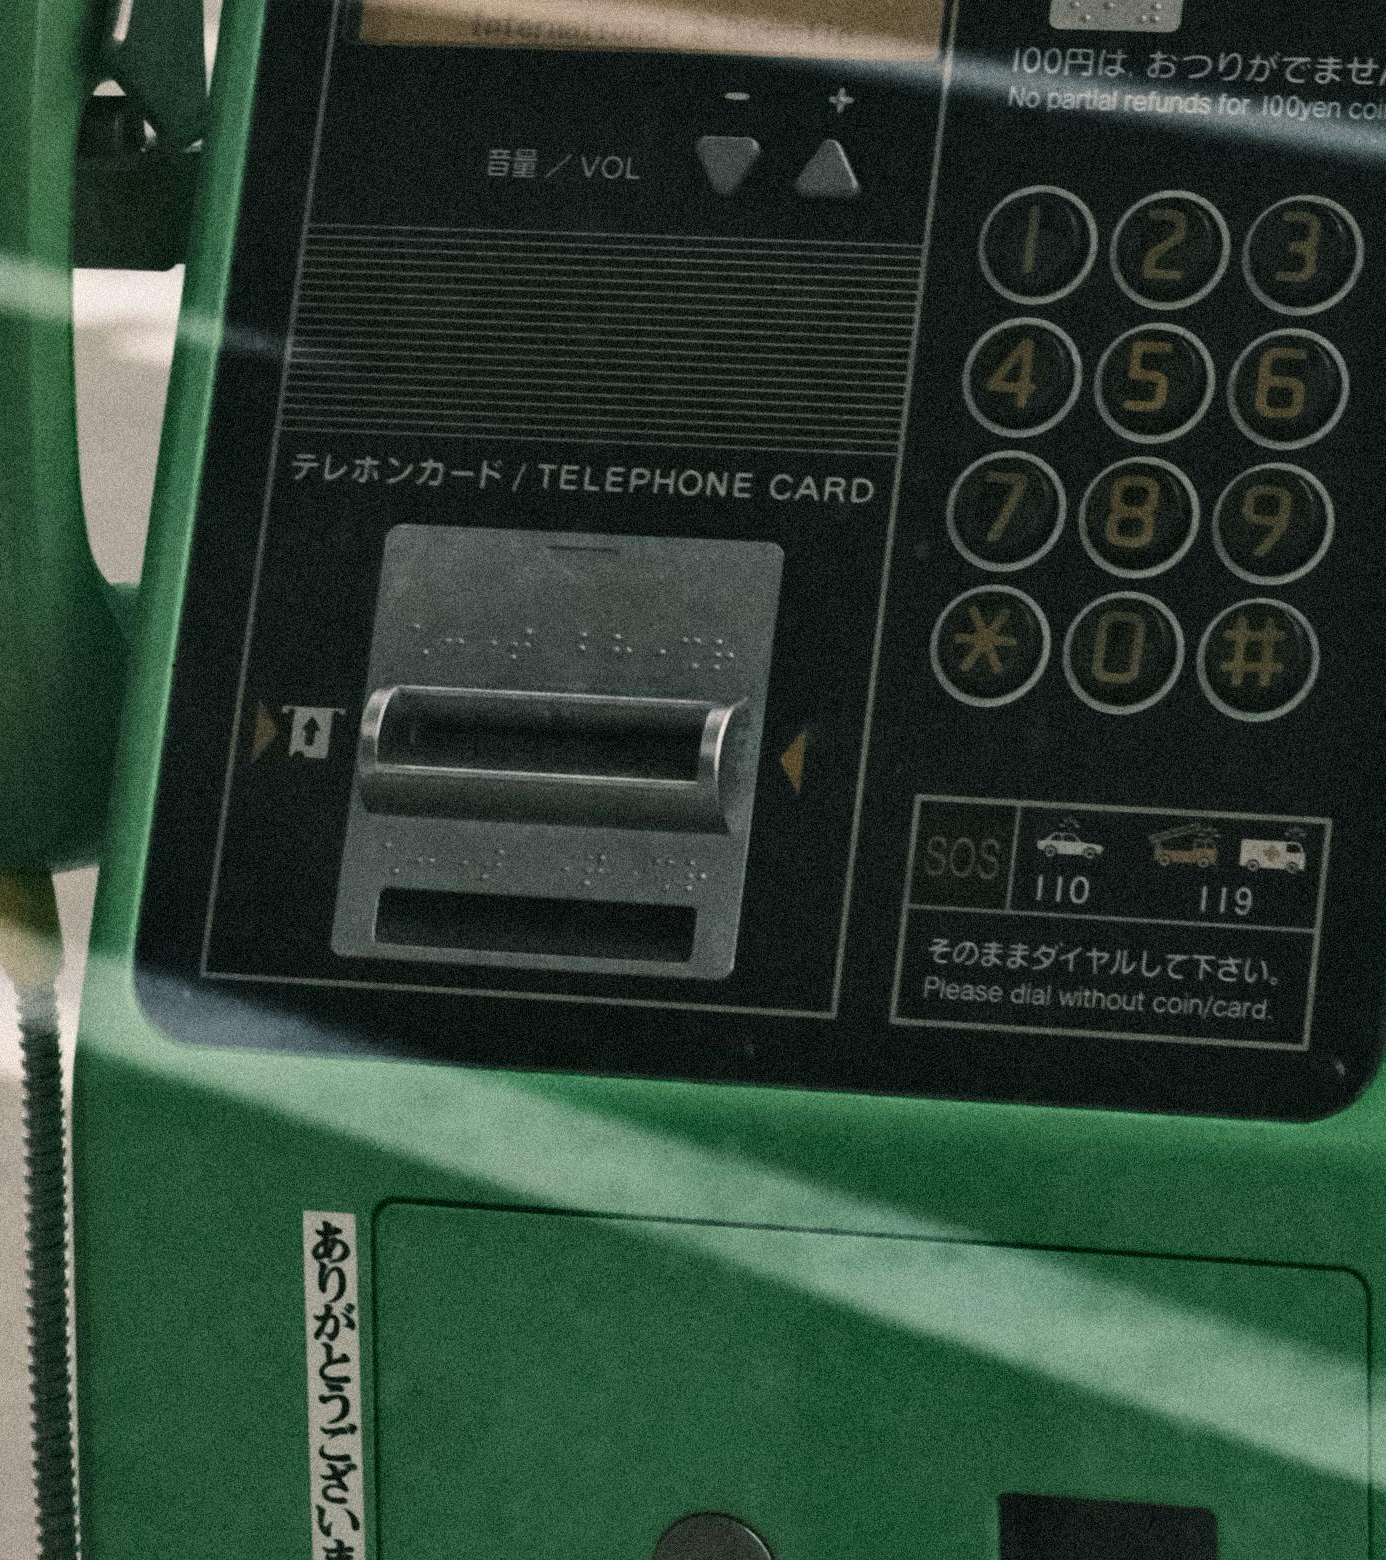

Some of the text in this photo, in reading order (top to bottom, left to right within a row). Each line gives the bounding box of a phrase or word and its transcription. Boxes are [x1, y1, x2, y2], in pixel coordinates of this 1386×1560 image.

[1008, 87, 1042, 112] No
[1046, 89, 1117, 118] partial
[1122, 90, 1211, 118] refunds
[1216, 93, 1250, 117] for
[486, 147, 540, 180] 音量
[581, 155, 641, 181] VOL
[1140, 207, 1189, 281] 2
[1274, 210, 1324, 283] 3
[986, 338, 1310, 421] 4 5 6
[290, 451, 502, 486] テレホンカード
[537, 463, 754, 500] TELEPHONE
[768, 472, 876, 505] CARD
[984, 470, 1295, 558] 7 8 9
[923, 834, 1001, 882] SOS
[1034, 874, 1091, 906] 110
[1199, 884, 1254, 917] 119
[927, 937, 1280, 987] そのままダイヤルして下さい。
[923, 975, 1273, 1022] Please dial without coin/card.
